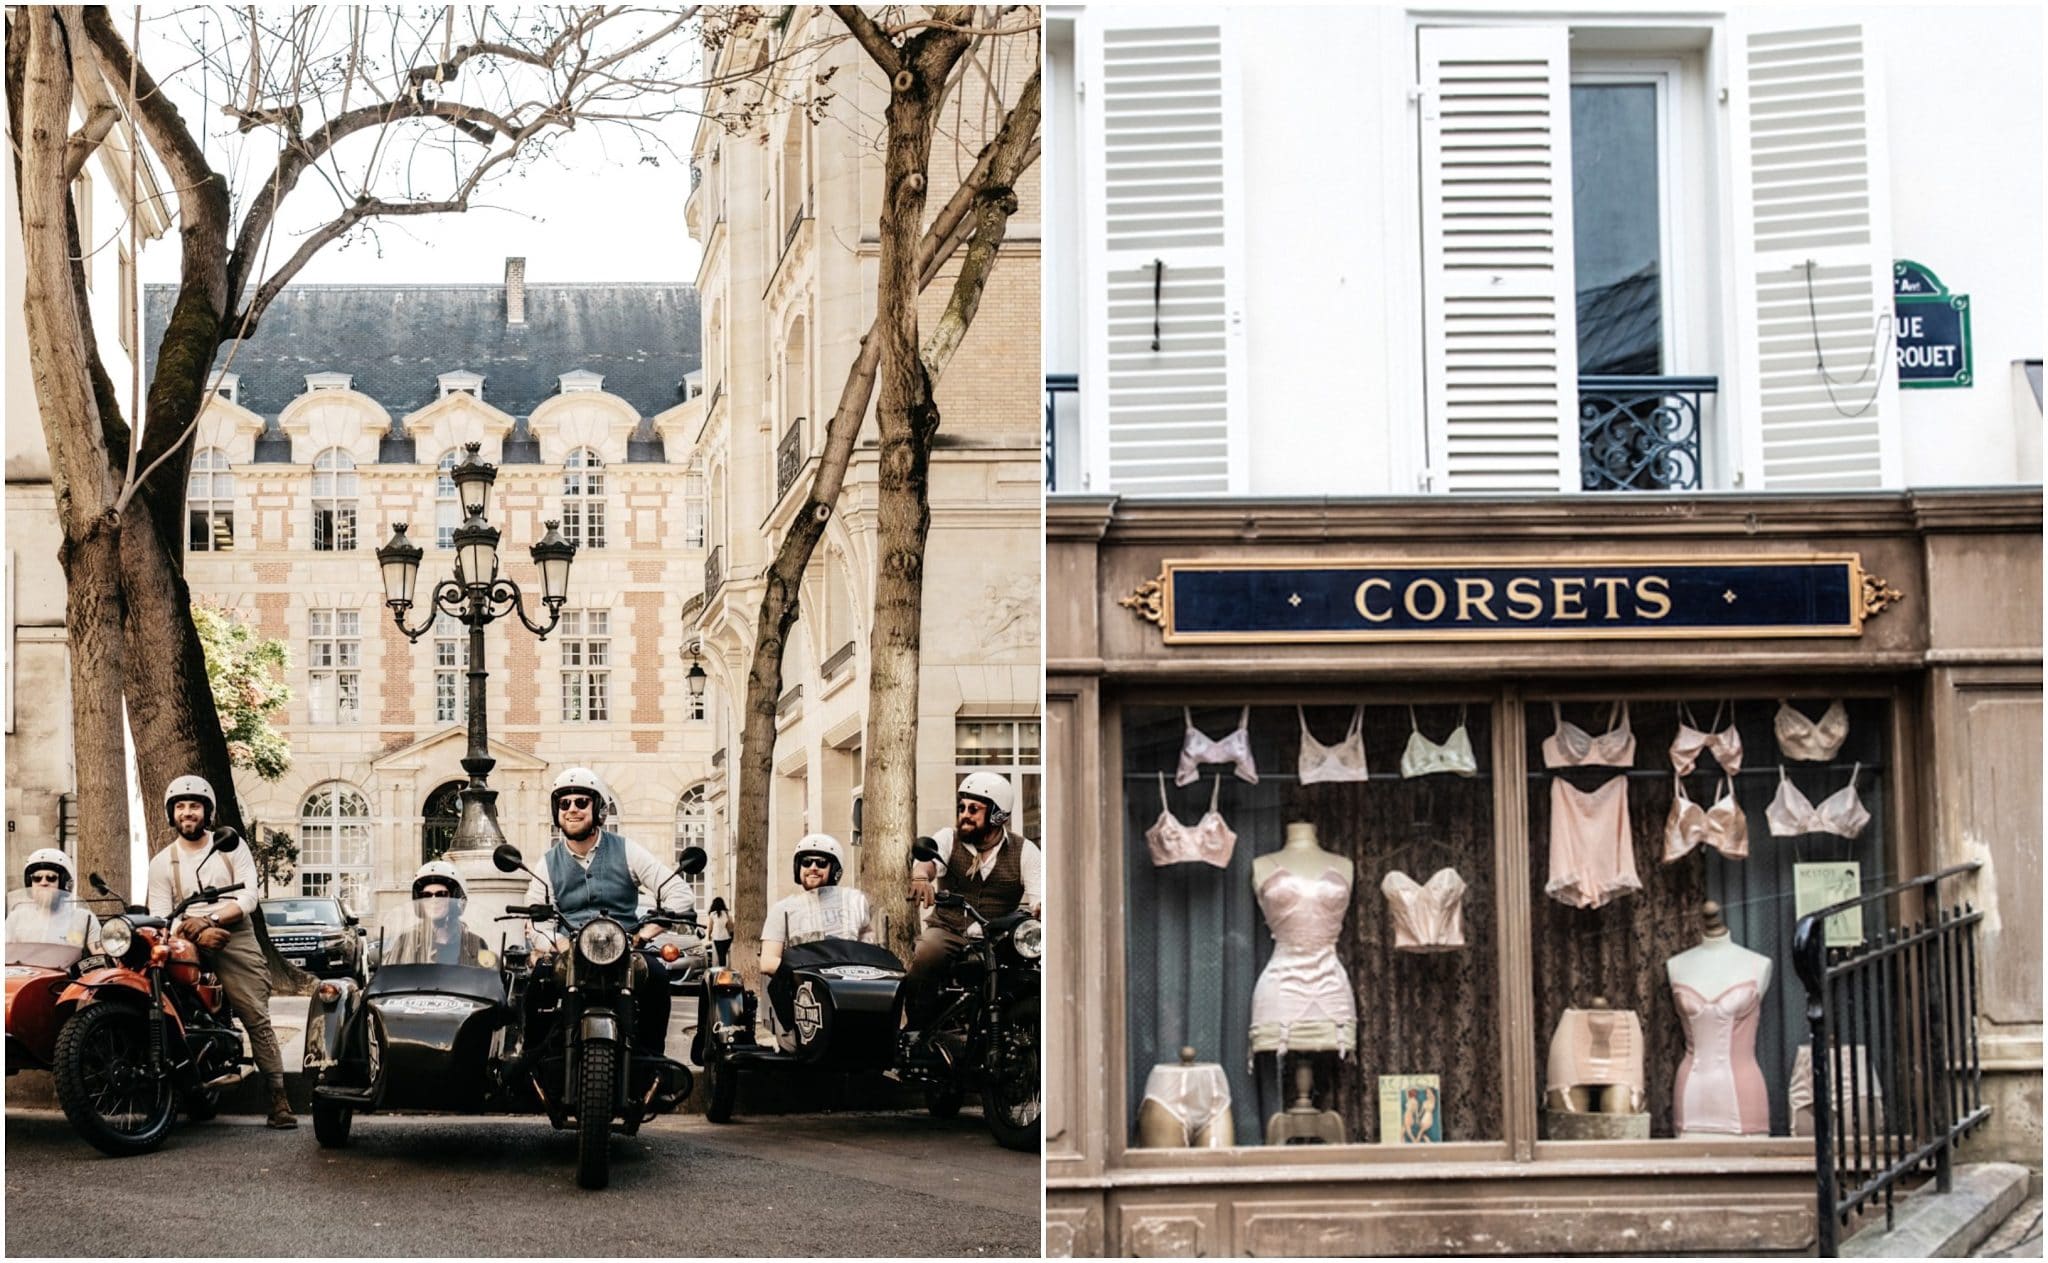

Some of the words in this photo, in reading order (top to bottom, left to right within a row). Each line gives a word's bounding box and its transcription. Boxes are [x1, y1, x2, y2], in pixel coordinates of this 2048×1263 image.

[1895, 316, 1924, 338] UE
[1896, 345, 1956, 368] ROUET
[1354, 575, 1672, 623] CORSETS
